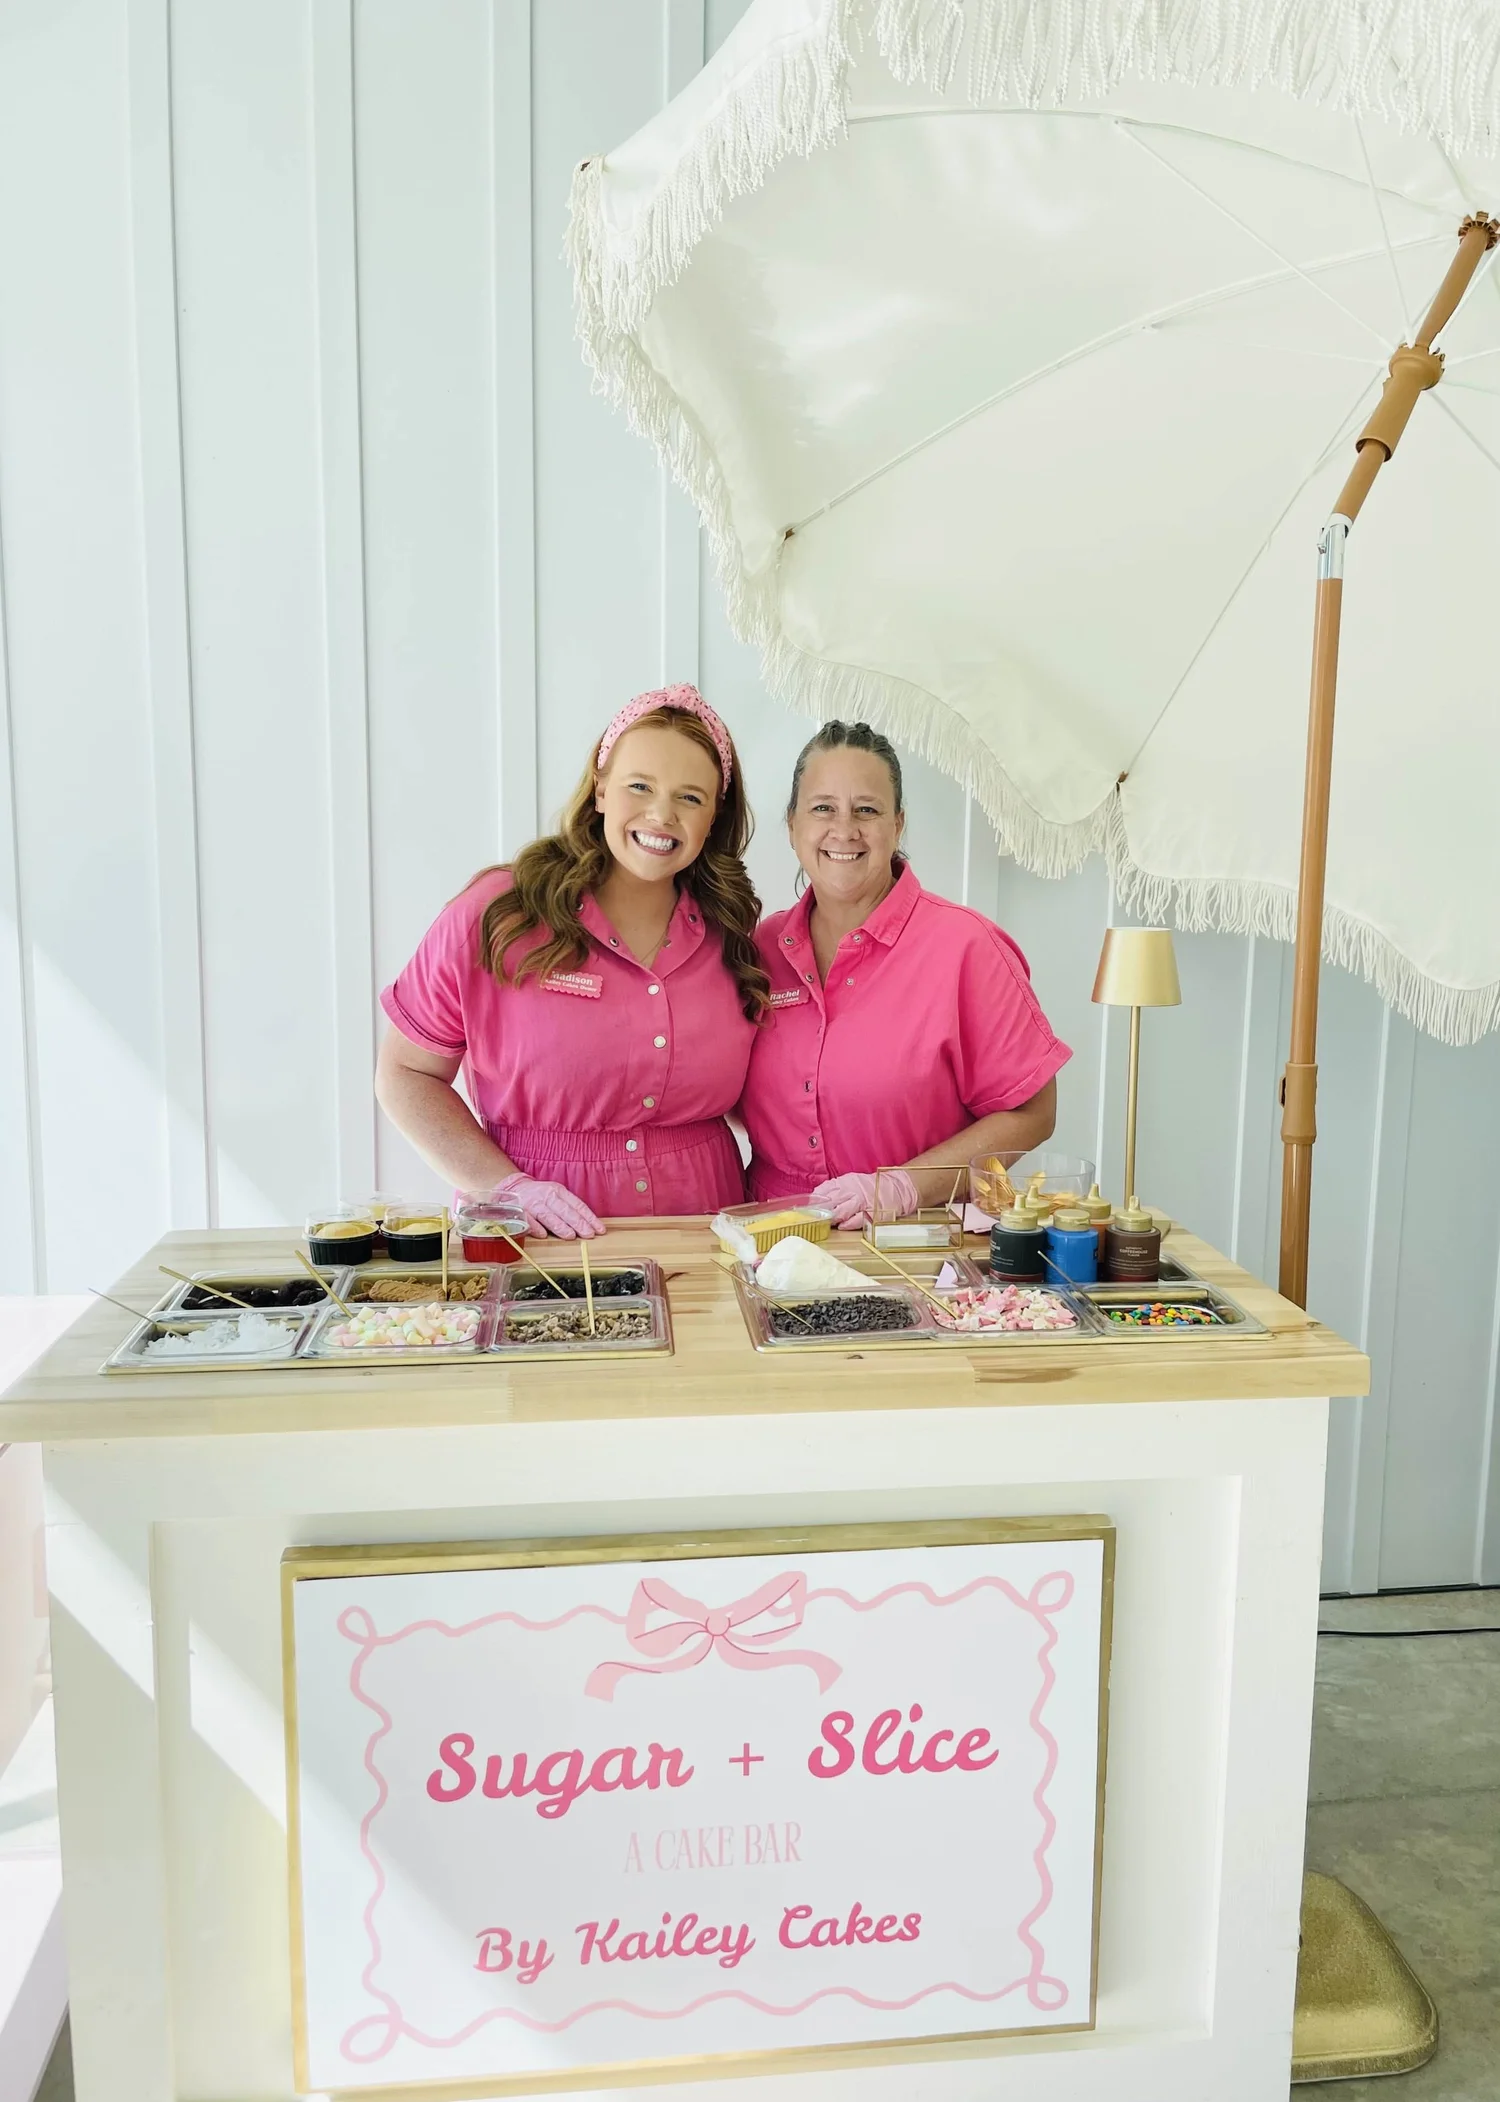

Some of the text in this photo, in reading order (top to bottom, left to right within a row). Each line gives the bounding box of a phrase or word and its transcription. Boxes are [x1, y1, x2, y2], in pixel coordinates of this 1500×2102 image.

[769, 989, 800, 1001] Rachel
[427, 1703, 999, 1819] Sugar + Slice
[624, 1821, 803, 1873] A CAKE BAR
[474, 1902, 922, 1984] By Kailey Cakes
